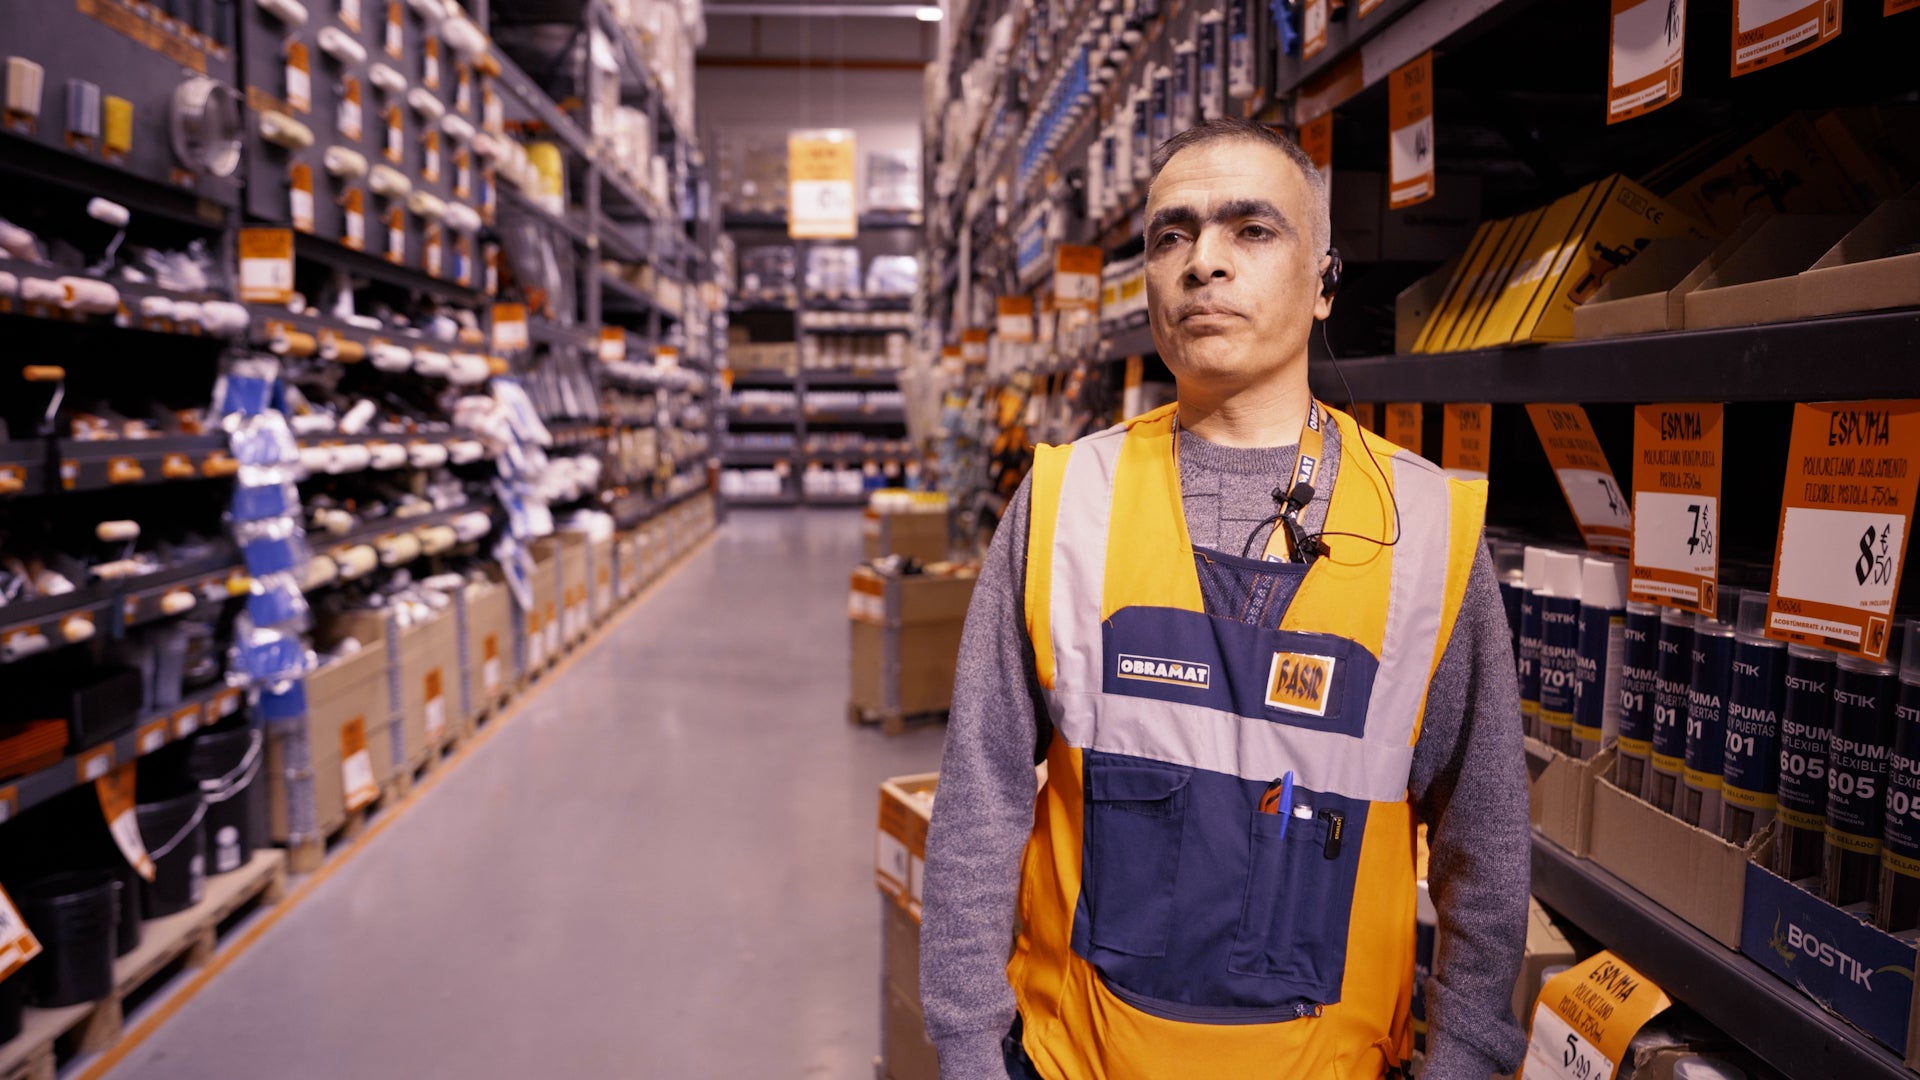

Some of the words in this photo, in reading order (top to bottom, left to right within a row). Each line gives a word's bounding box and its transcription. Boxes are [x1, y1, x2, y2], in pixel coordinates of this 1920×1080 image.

[1661, 411, 1702, 441] ESPUMA
[1829, 410, 1889, 446] ESPUMA
[1802, 456, 1856, 477] POLIURETANO
[1857, 458, 1908, 479] AISLAMIENTO
[1804, 482, 1837, 504] FLEXIBLE
[1838, 484, 1868, 505] PISTOLA
[1624, 629, 1647, 643] STIK
[1658, 640, 1679, 655] STIK
[1542, 644, 1577, 660] ESPUM
[1121, 659, 1207, 682] OBRAMAT
[1541, 668, 1575, 689] 701
[1731, 661, 1761, 678] STIK
[1785, 674, 1826, 694] OSTIK
[1688, 689, 1721, 709] PUMA
[1833, 688, 1876, 710] OSTIK
[1687, 717, 1702, 740] 01
[1736, 719, 1775, 738] PUERTAS
[1782, 718, 1832, 742] ESPUM
[1780, 750, 1825, 779] 605
[1828, 768, 1875, 799] 605
[1787, 922, 1874, 993] BOSTIK
[1588, 960, 1639, 1003] ESPUMA
[1558, 995, 1583, 1024] PISTOLA
